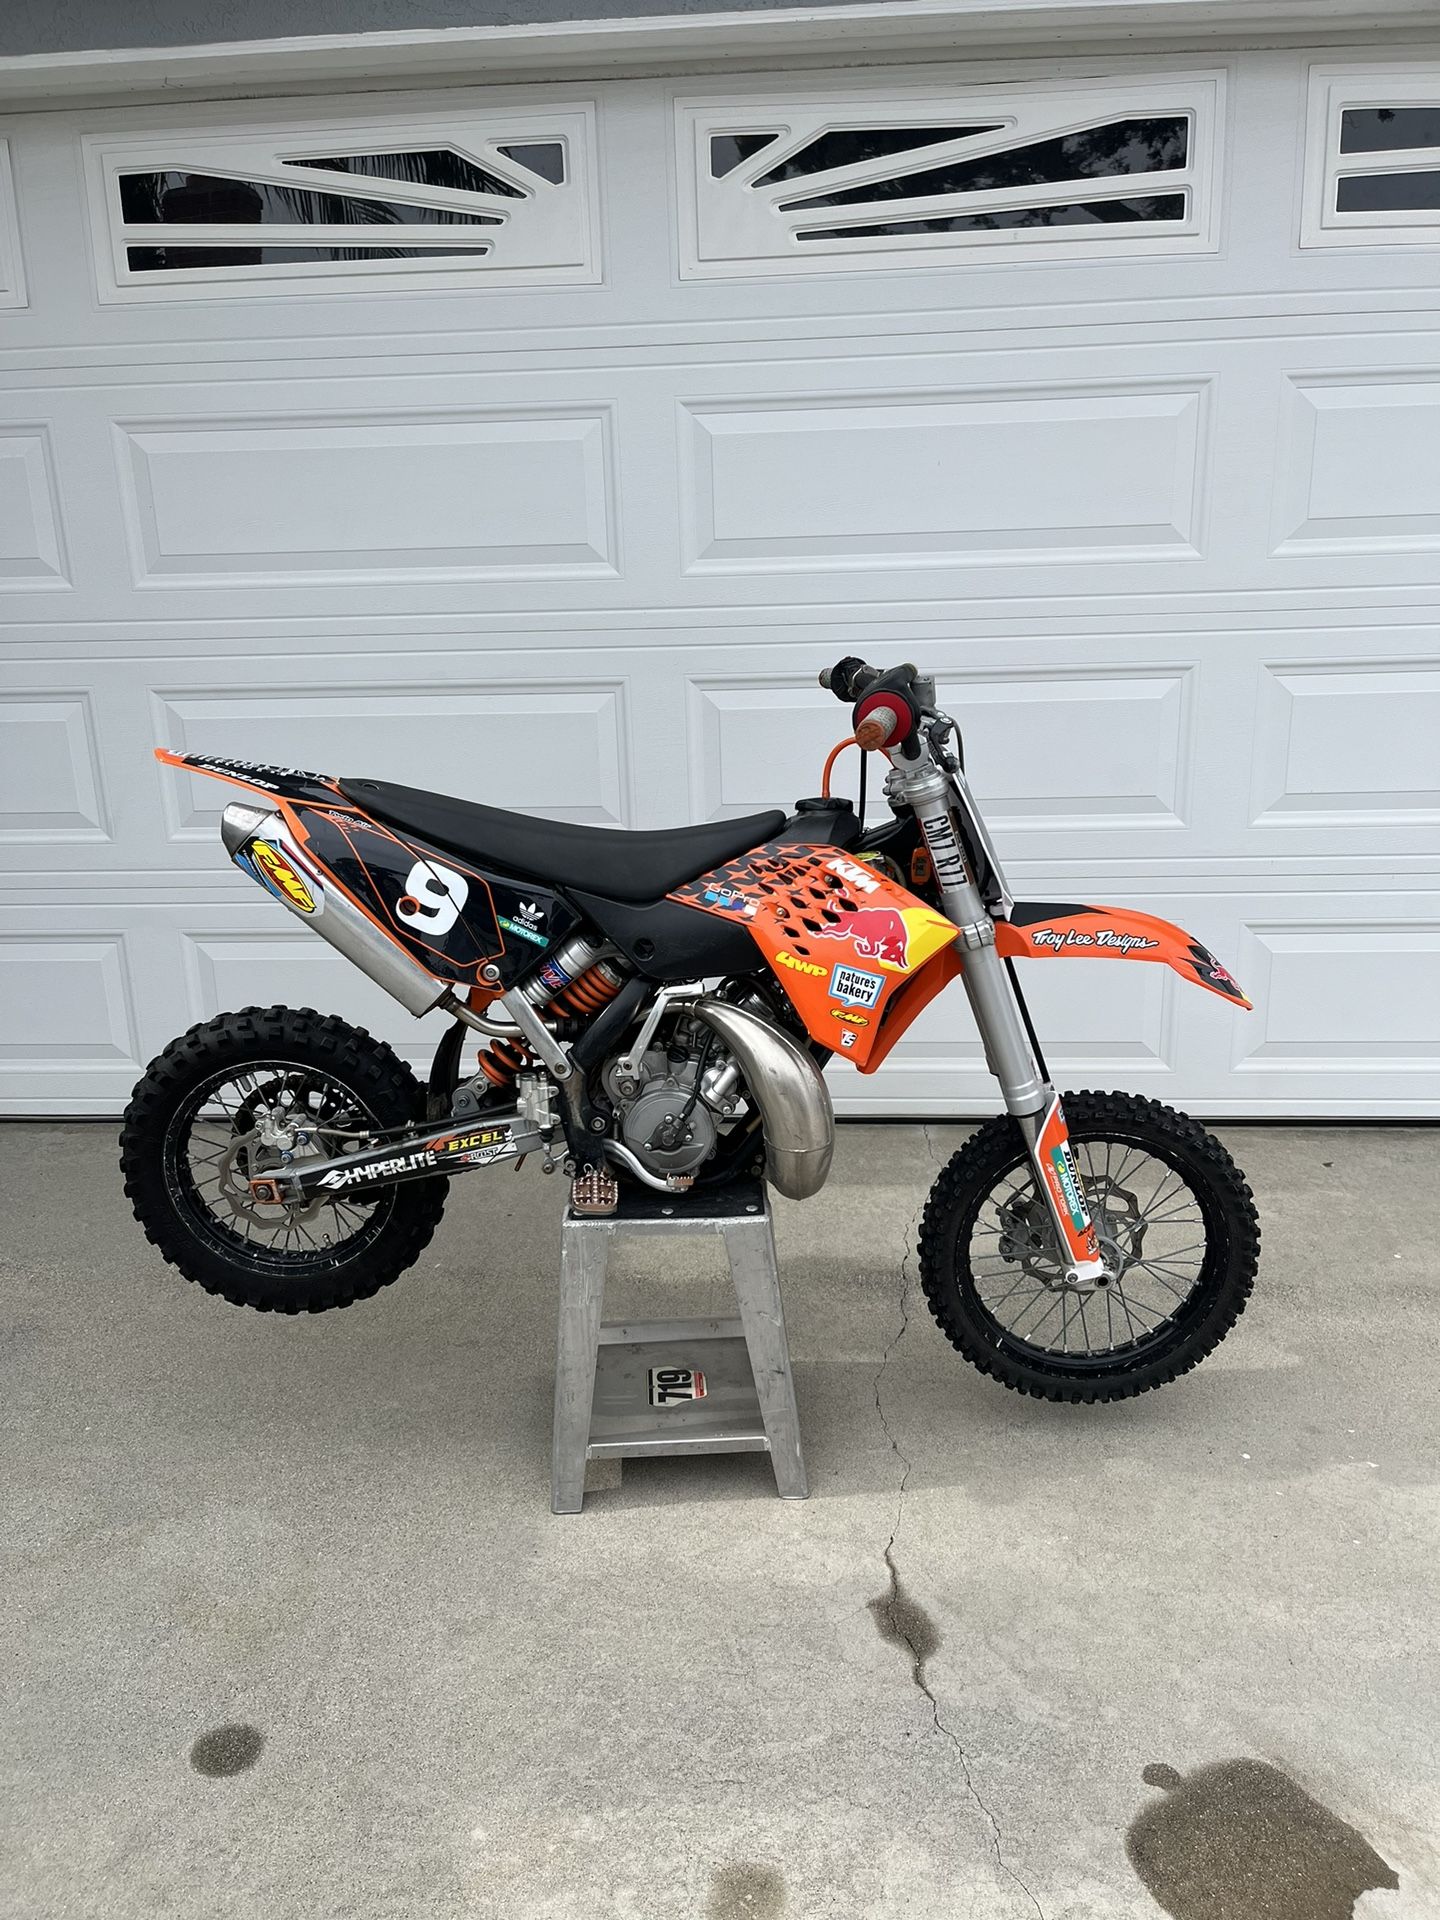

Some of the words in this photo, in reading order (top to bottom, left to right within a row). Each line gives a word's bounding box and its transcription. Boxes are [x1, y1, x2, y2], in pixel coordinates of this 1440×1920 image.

[198, 763, 280, 790] DUNLOP
[923, 814, 957, 852] CM7
[251, 841, 317, 910] FMF
[825, 857, 881, 895] KTM
[937, 851, 968, 889] R77
[395, 859, 469, 936] 9
[708, 882, 760, 907] GoPro
[509, 922, 543, 944] MOTOREX
[512, 915, 538, 932] adidas
[1032, 928, 1066, 953] Troy
[1065, 929, 1095, 946] Lee
[1095, 929, 1159, 955] Designs
[836, 980, 874, 1002] bakery
[448, 1131, 503, 1152] EXCEL
[343, 1150, 438, 1185] HYPERLITE
[1064, 1150, 1089, 1217] DUNLOP
[1060, 1172, 1079, 1215] MOTOREX
[656, 1369, 692, 1403] 719
